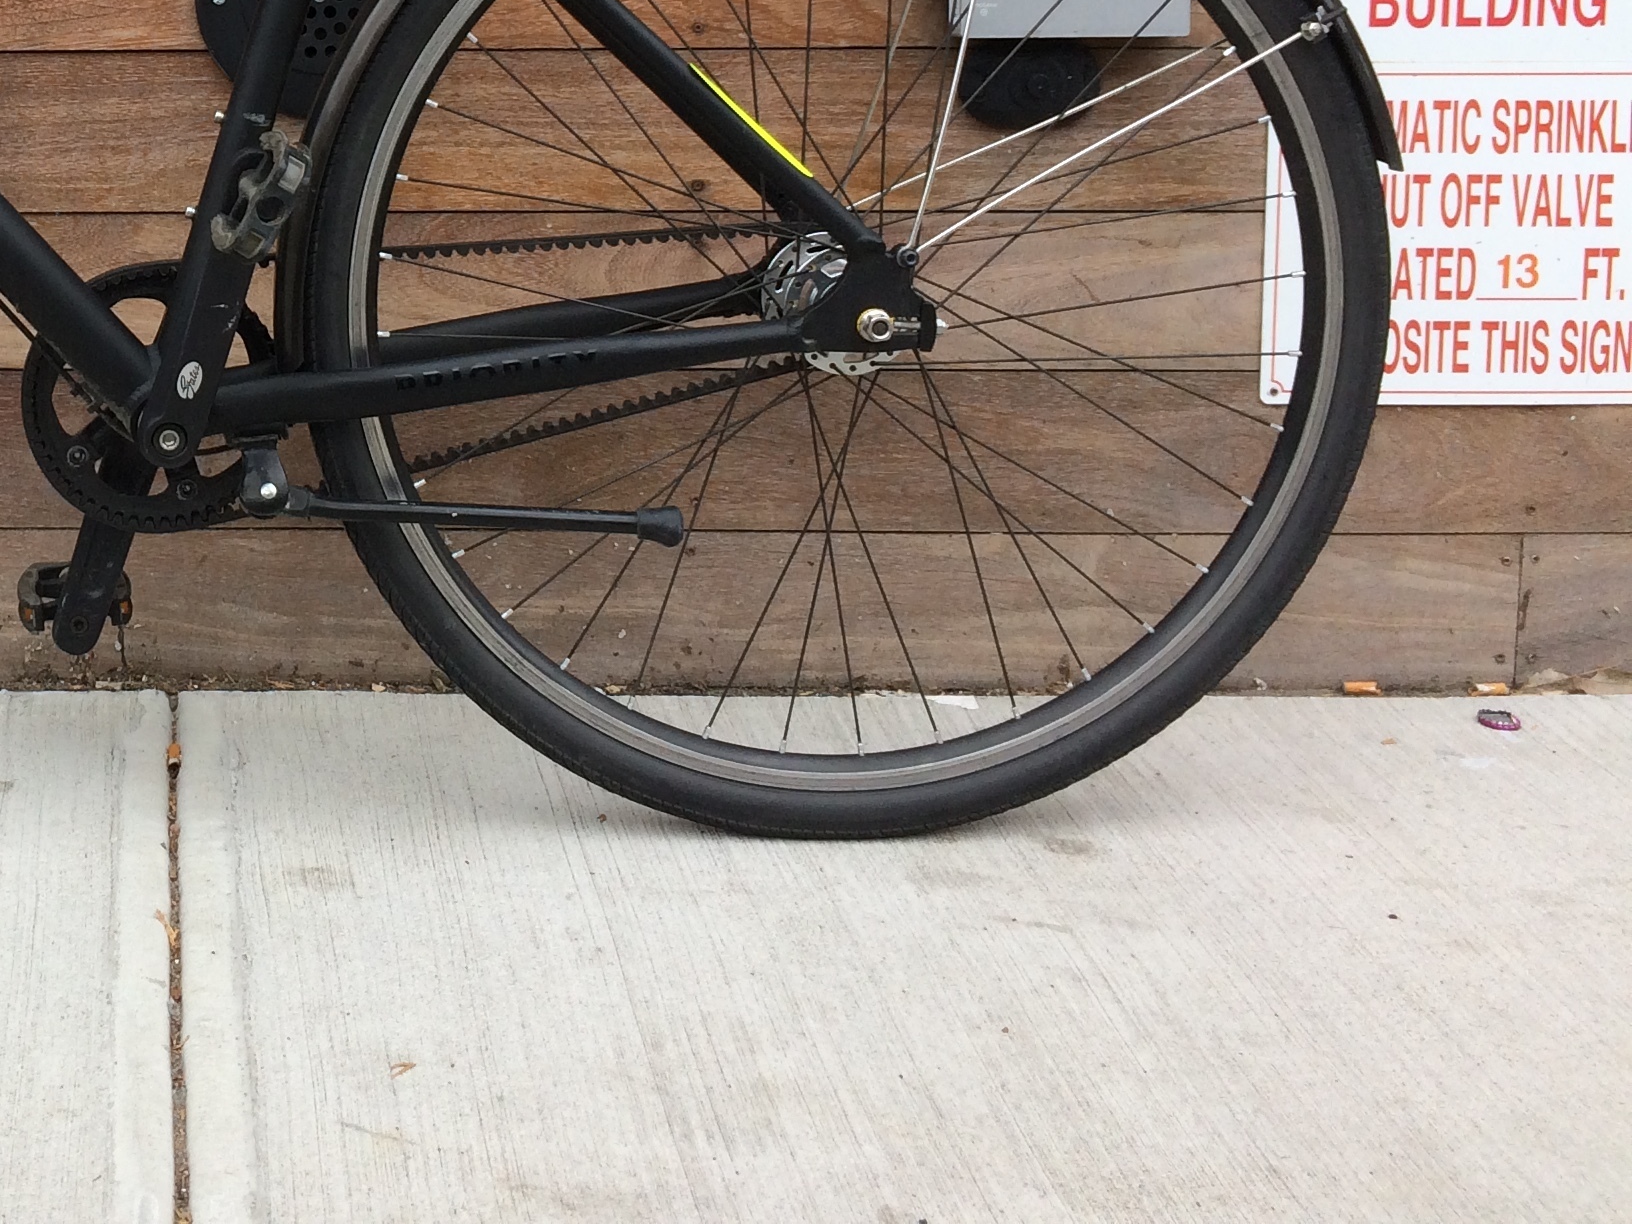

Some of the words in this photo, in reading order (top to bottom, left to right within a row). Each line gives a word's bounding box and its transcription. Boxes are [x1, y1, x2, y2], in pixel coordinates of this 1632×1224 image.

[1386, 99, 1482, 155] MATIC
[1491, 99, 1632, 155] SPRINKL
[1440, 173, 1503, 228] OFF
[1512, 173, 1614, 228] VALVE
[1391, 247, 1477, 301] ATED
[1497, 253, 1540, 290] 13
[1581, 247, 1625, 301] FT.
[1383, 319, 1471, 375] OSITE
[1481, 319, 1550, 375] THIS
[1559, 319, 1632, 375] SIGN
